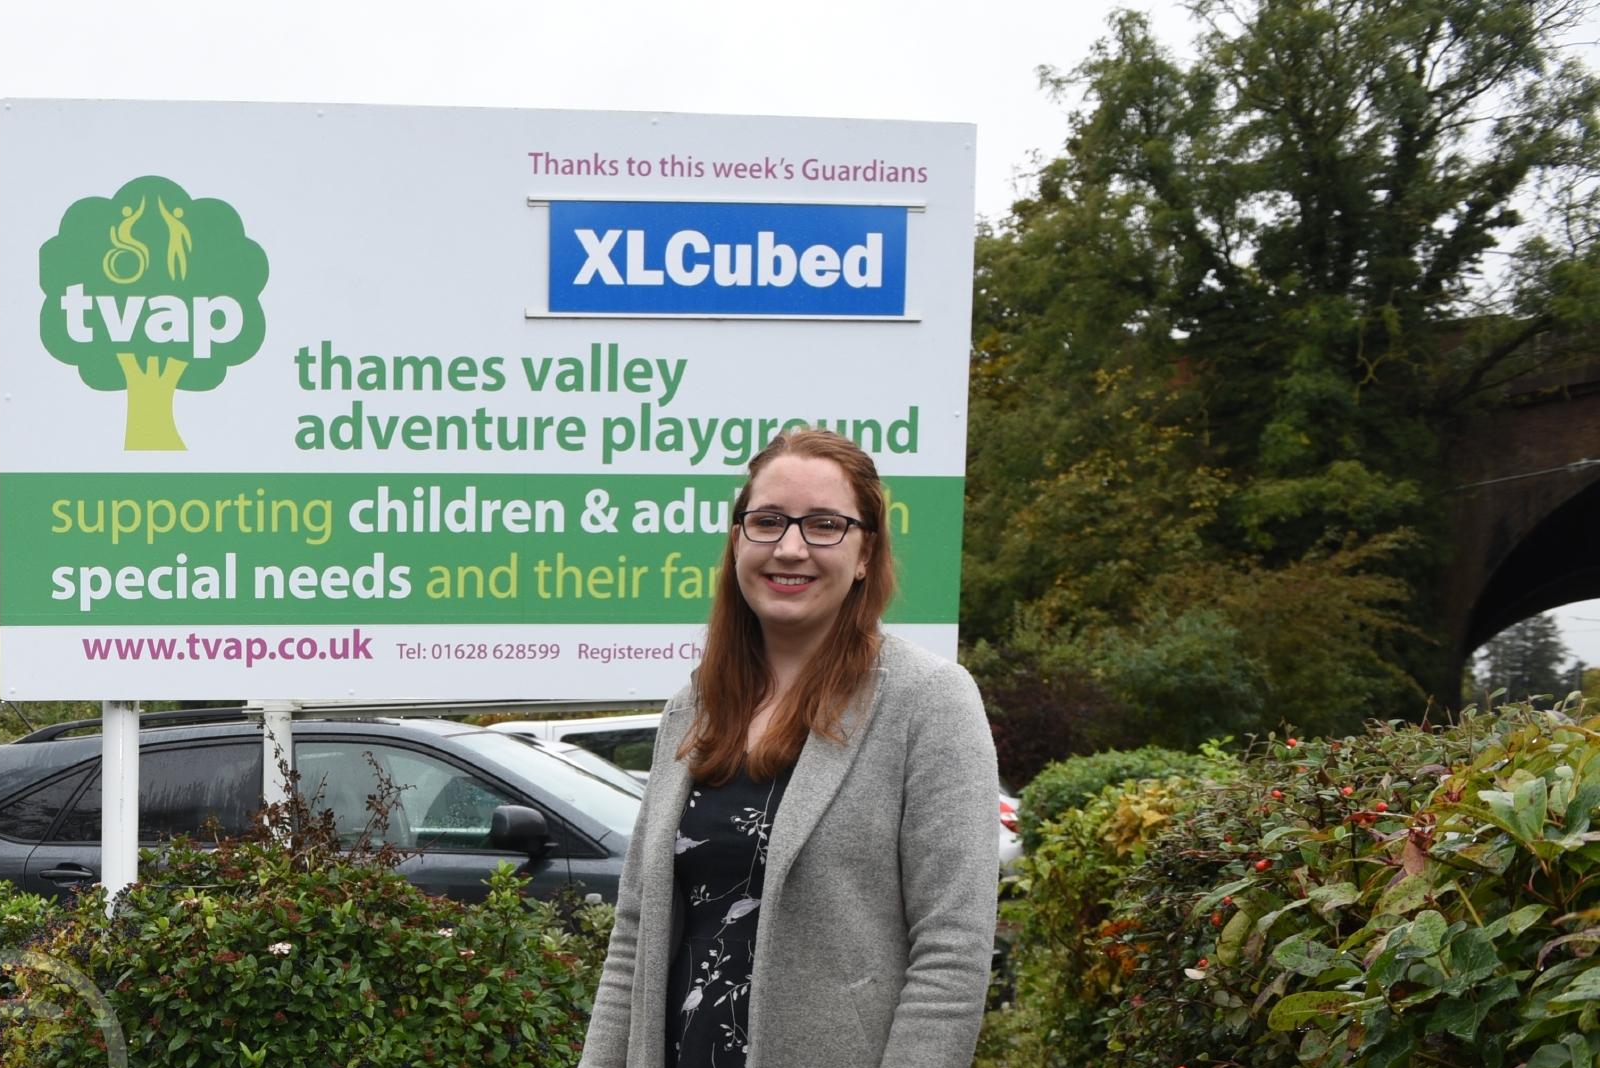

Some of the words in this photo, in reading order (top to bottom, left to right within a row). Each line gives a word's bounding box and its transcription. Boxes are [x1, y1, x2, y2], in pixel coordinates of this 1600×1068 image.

[528, 151, 619, 177] Thanks
[626, 156, 653, 178] to
[659, 154, 705, 179] this
[801, 159, 929, 184] Guardians
[573, 229, 883, 288] XLCubed
[60, 283, 244, 359] tvap
[294, 340, 507, 391] thames
[522, 342, 688, 407] valley
[294, 401, 587, 451] adventure
[51, 487, 332, 545] supporting
[348, 485, 566, 534] children
[580, 488, 621, 534] &
[51, 552, 237, 612] special
[254, 551, 412, 600] needs
[426, 552, 518, 599] and
[534, 552, 649, 599] their
[82, 628, 375, 668] www.tvap.co.uk
[395, 642, 427, 659] Tel:
[431, 643, 488, 660] 01628
[492, 643, 561, 660] 628599
[578, 642, 674, 664] Registered
